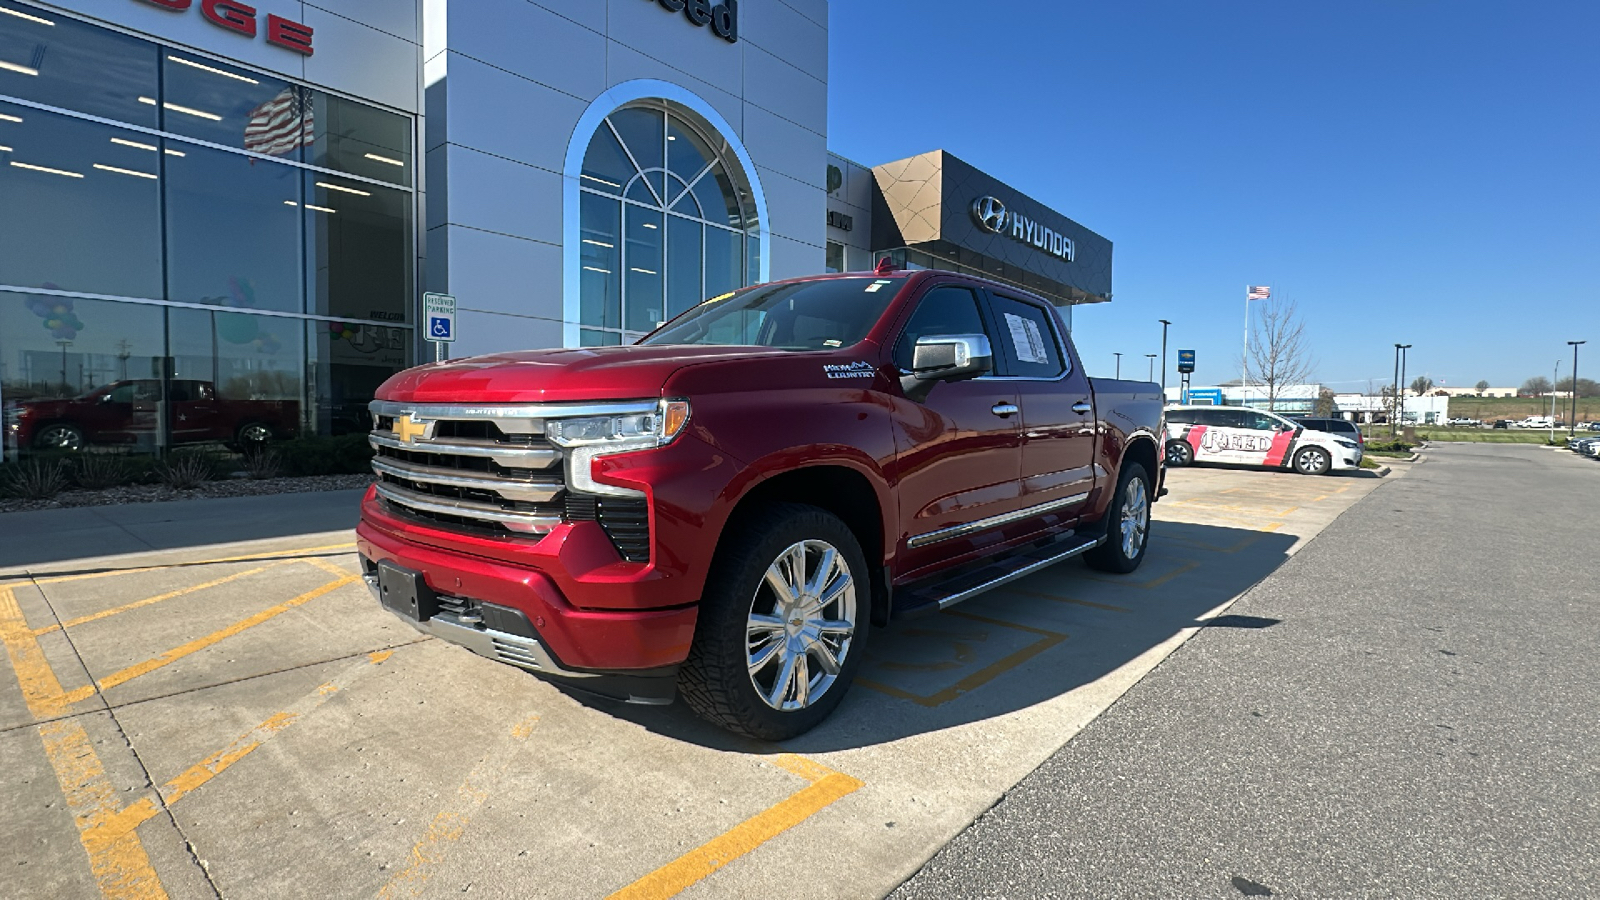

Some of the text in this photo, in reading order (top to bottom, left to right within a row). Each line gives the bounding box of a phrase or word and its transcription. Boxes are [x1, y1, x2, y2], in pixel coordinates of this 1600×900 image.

[133, 0, 314, 57] GE
[1012, 211, 1075, 262] HYUNDAI
[427, 297, 454, 306] RESERVED
[427, 305, 454, 314] PARKING
[827, 371, 875, 379] COUNTRY
[1202, 430, 1272, 452] REED
